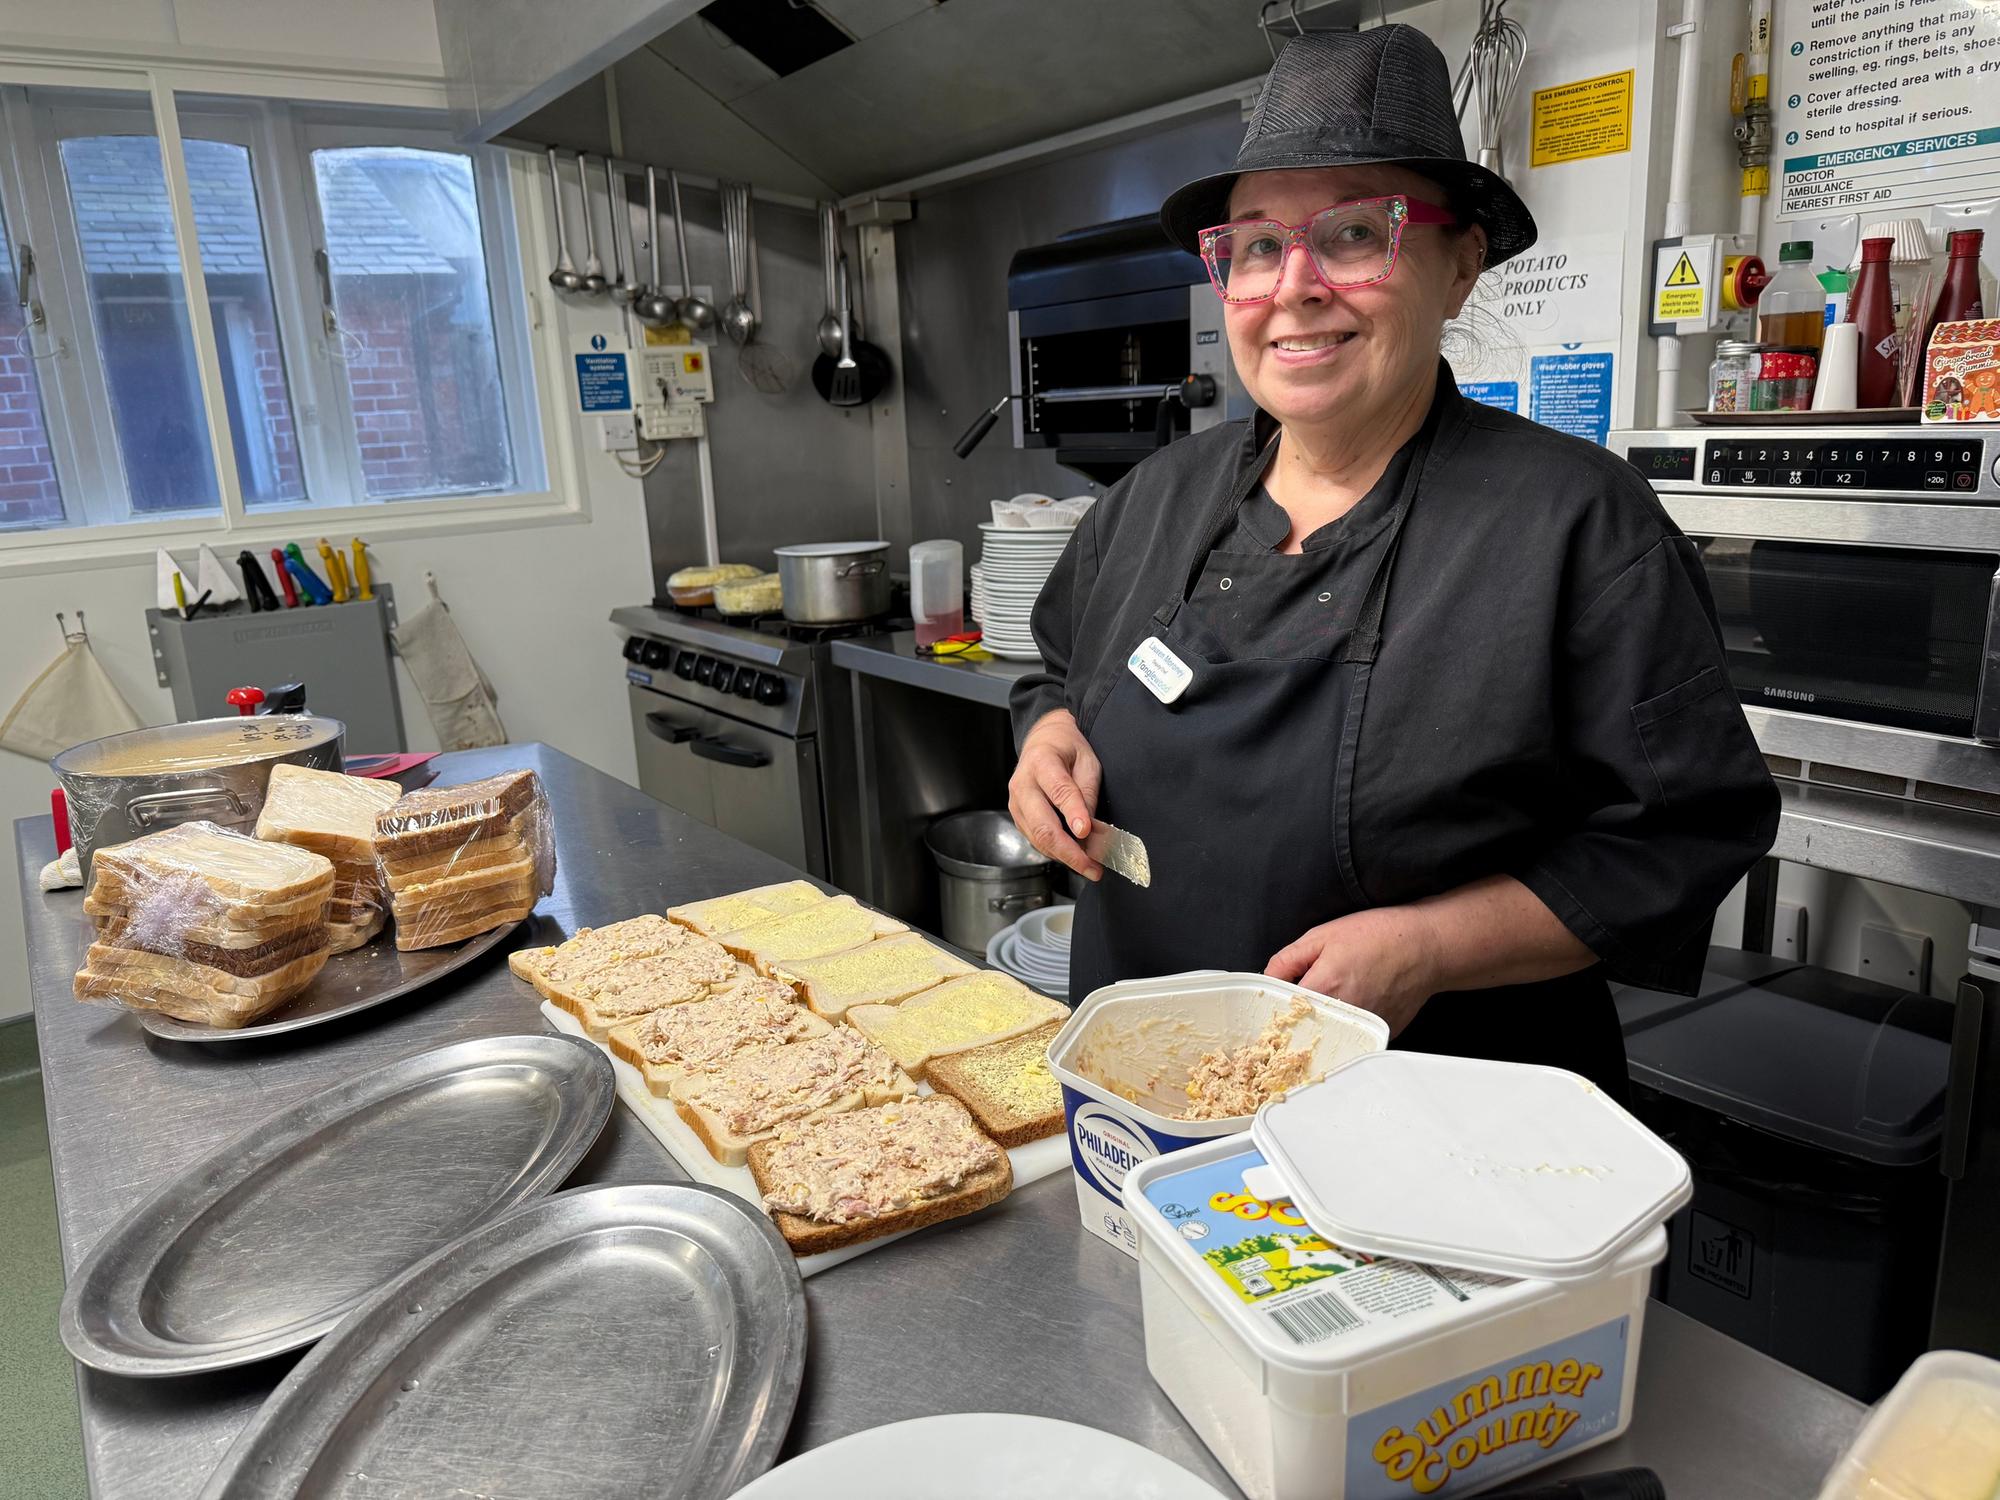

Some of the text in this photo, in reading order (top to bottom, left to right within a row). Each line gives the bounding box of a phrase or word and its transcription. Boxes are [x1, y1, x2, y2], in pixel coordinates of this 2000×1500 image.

[1811, 15, 1836, 29] until
[1841, 11, 1859, 23] the
[1864, 3, 1890, 20] pain
[1894, 0, 1905, 11] is
[1812, 0, 1845, 14] water
[1758, 18, 1767, 40] GAS
[1791, 42, 1803, 55] 2
[1810, 33, 1857, 51] Remove
[1861, 22, 1914, 42] anything
[1919, 14, 1944, 28] that
[1949, 7, 1977, 22] may
[1809, 25, 1975, 66] constriction if there is any
[1808, 64, 1859, 82] swelling,
[1862, 60, 1881, 72] eg.
[1884, 52, 1919, 68] rings,
[1922, 44, 1959, 60] belts,
[1554, 85, 1592, 98] EMERGENCY
[1593, 78, 1624, 88] CONTROL
[1788, 60, 2000, 108] 3 Cover affected area with a dry
[1806, 94, 1902, 119] sterile dressing.
[1786, 105, 1973, 145] 4 Send to hospital if serious.
[1817, 132, 1978, 168] EMERGENCY SERVICES
[1788, 169, 1835, 184] DOCTOR
[1787, 180, 1854, 197] AMBULANCE
[1786, 189, 1893, 211] NEAREST FIRST AID
[1504, 254, 1567, 276] POTATO
[1504, 274, 1588, 297] PRODUCTS
[1504, 300, 1546, 317] ONLY
[1539, 361, 1606, 372] Wear rubber gloves
[1933, 345, 1993, 372] Gingerbread
[1713, 451, 1971, 462] P 1 2 3 4 5 6 7 8 9 0
[1763, 687, 1815, 703] SAMSUNG
[1102, 1130, 1132, 1150] ORIGINAL
[1371, 1357, 1602, 1482] Summer
[1410, 1400, 1581, 1495] County
